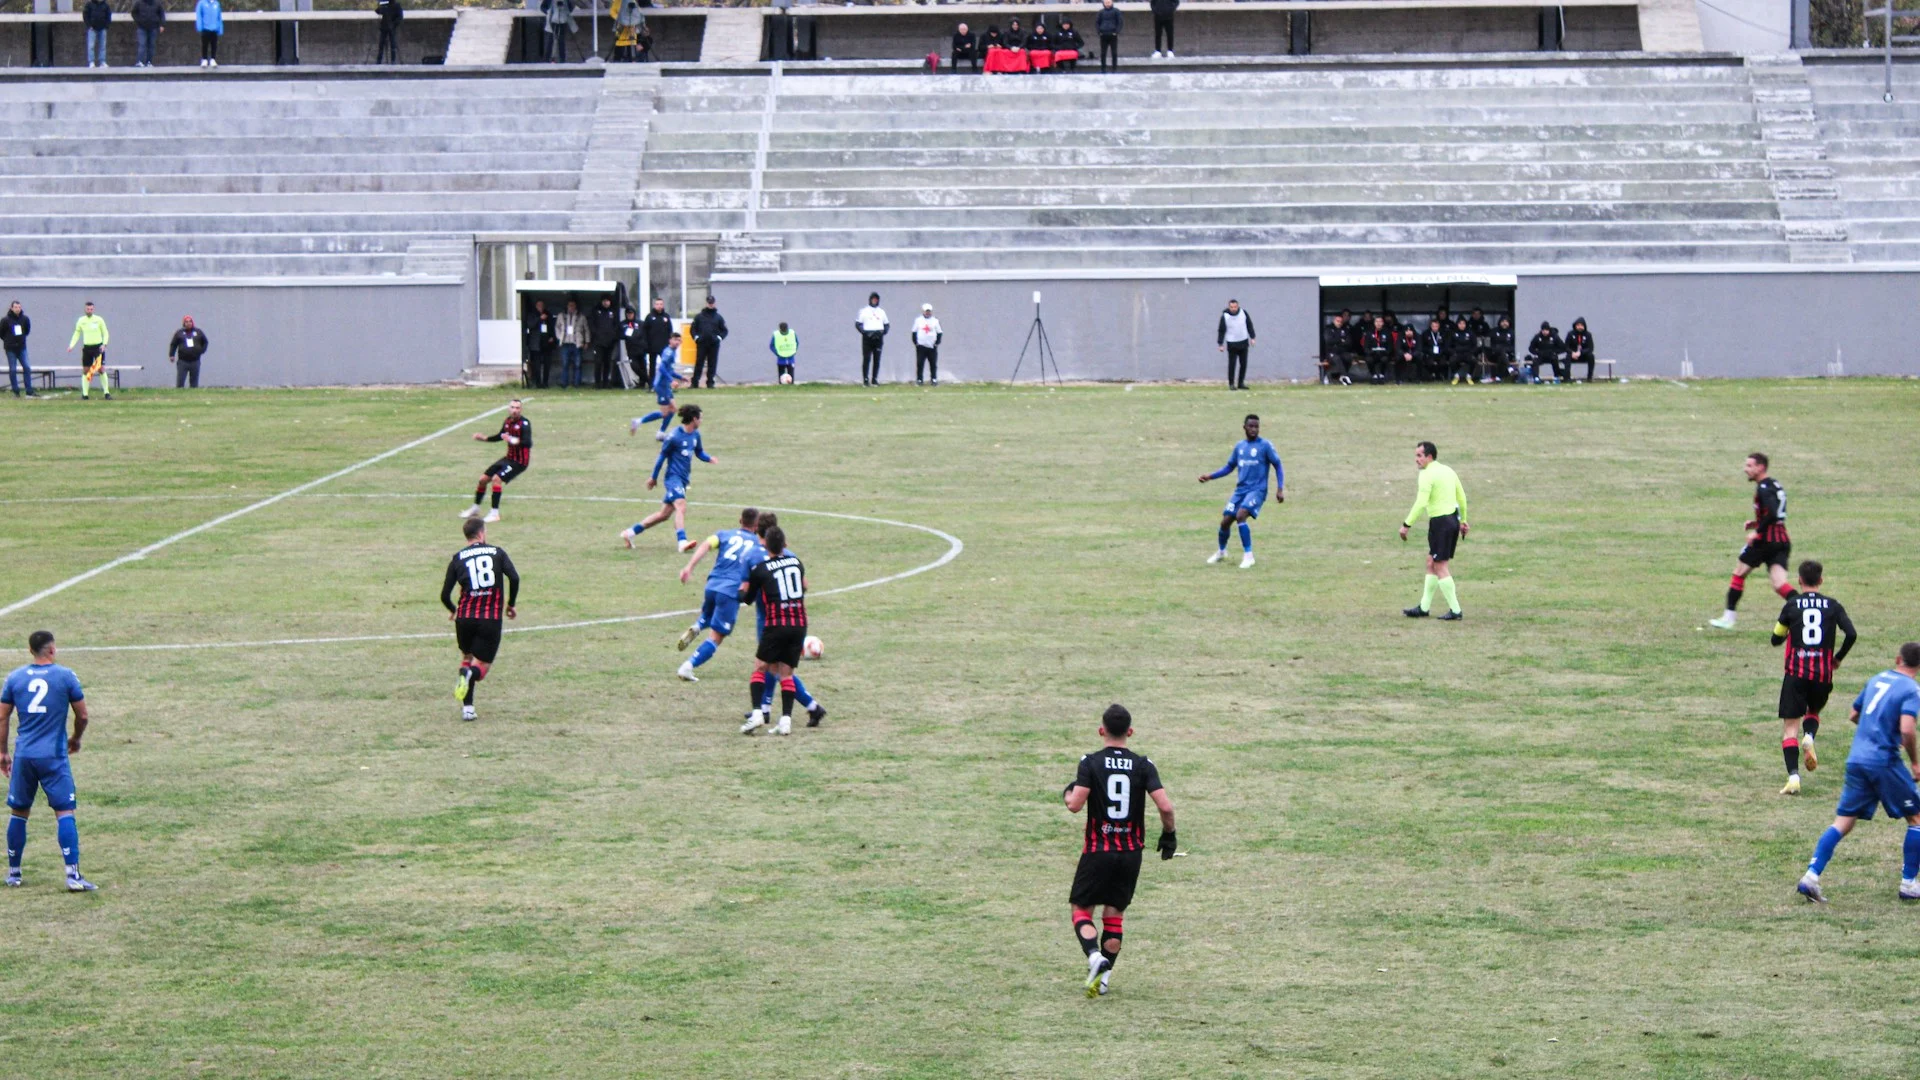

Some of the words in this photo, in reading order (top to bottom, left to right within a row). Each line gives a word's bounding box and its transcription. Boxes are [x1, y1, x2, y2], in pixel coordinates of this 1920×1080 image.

[724, 536, 754, 563] 21
[466, 555, 495, 590] 18
[773, 566, 803, 600] 10
[1796, 599, 1829, 609] TOTRE
[1802, 608, 1822, 645] 8
[27, 678, 49, 713] 2
[1865, 681, 1891, 715] 7
[1104, 756, 1133, 770] ELEZI
[1107, 773, 1131, 819] 9
